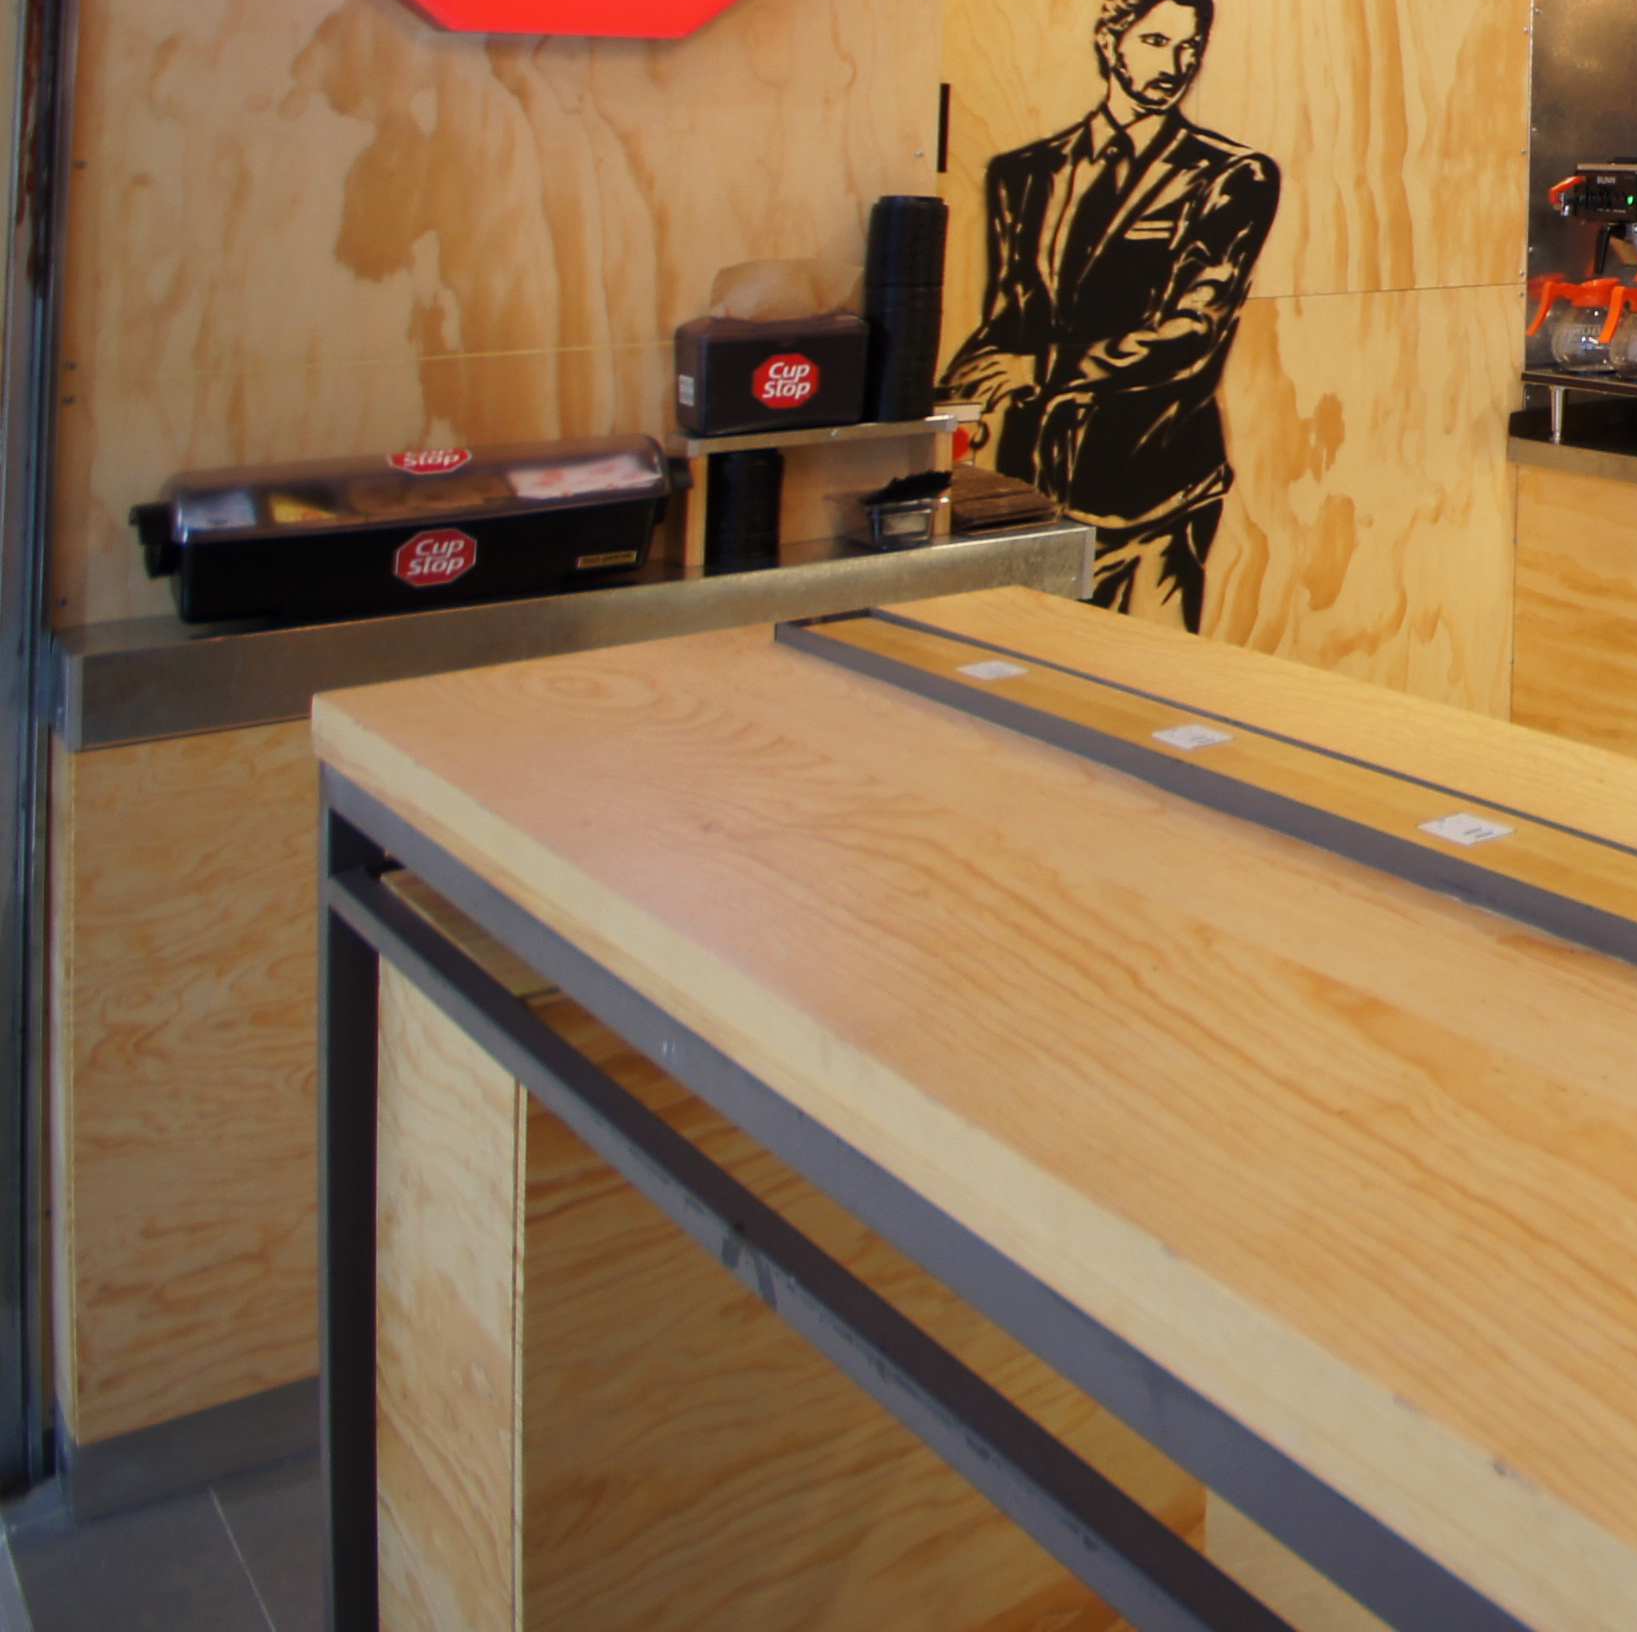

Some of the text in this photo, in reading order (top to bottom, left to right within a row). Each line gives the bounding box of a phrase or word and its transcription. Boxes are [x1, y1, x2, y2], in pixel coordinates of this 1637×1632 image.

[768, 361, 811, 382] Cup
[762, 379, 811, 400] Stop
[415, 537, 465, 558] Cup
[407, 554, 465, 576] Stop
